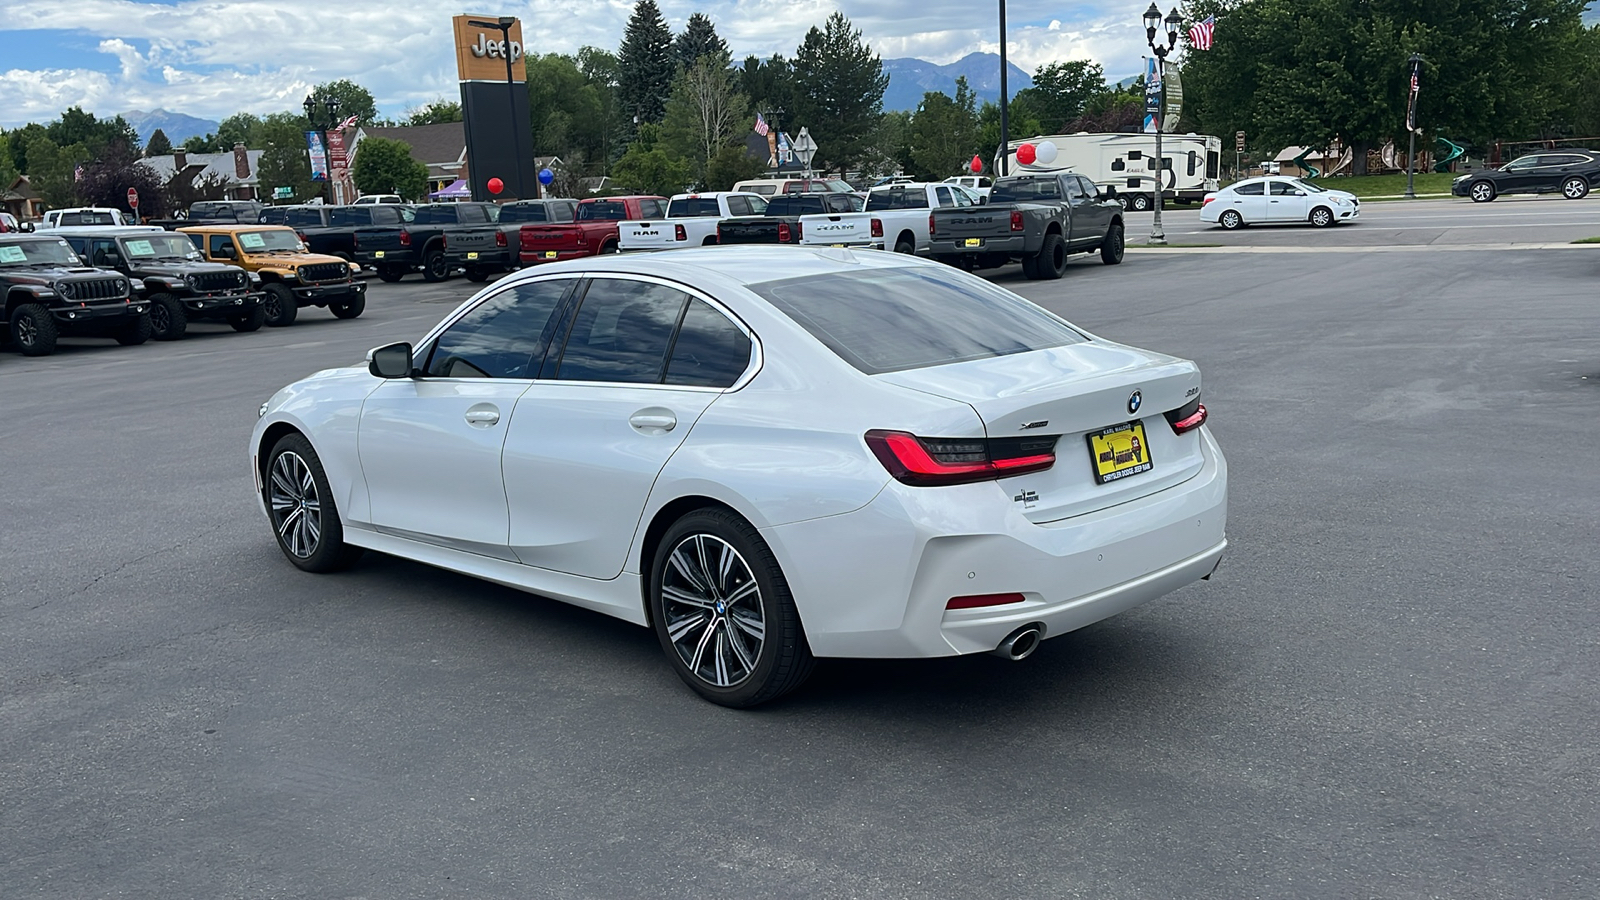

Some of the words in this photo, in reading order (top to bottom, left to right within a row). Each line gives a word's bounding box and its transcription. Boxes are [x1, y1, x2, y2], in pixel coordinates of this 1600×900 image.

[471, 33, 522, 64] Jeep
[951, 217, 993, 225] RAM
[816, 222, 855, 231] RAM
[1115, 424, 1132, 432] MALONE
[1132, 439, 1139, 447] 32
[1103, 471, 1122, 482] CHRYSLER
[1121, 467, 1134, 477] DODGE
[1134, 465, 1143, 474] JEEP
[1142, 463, 1151, 472] RAM
